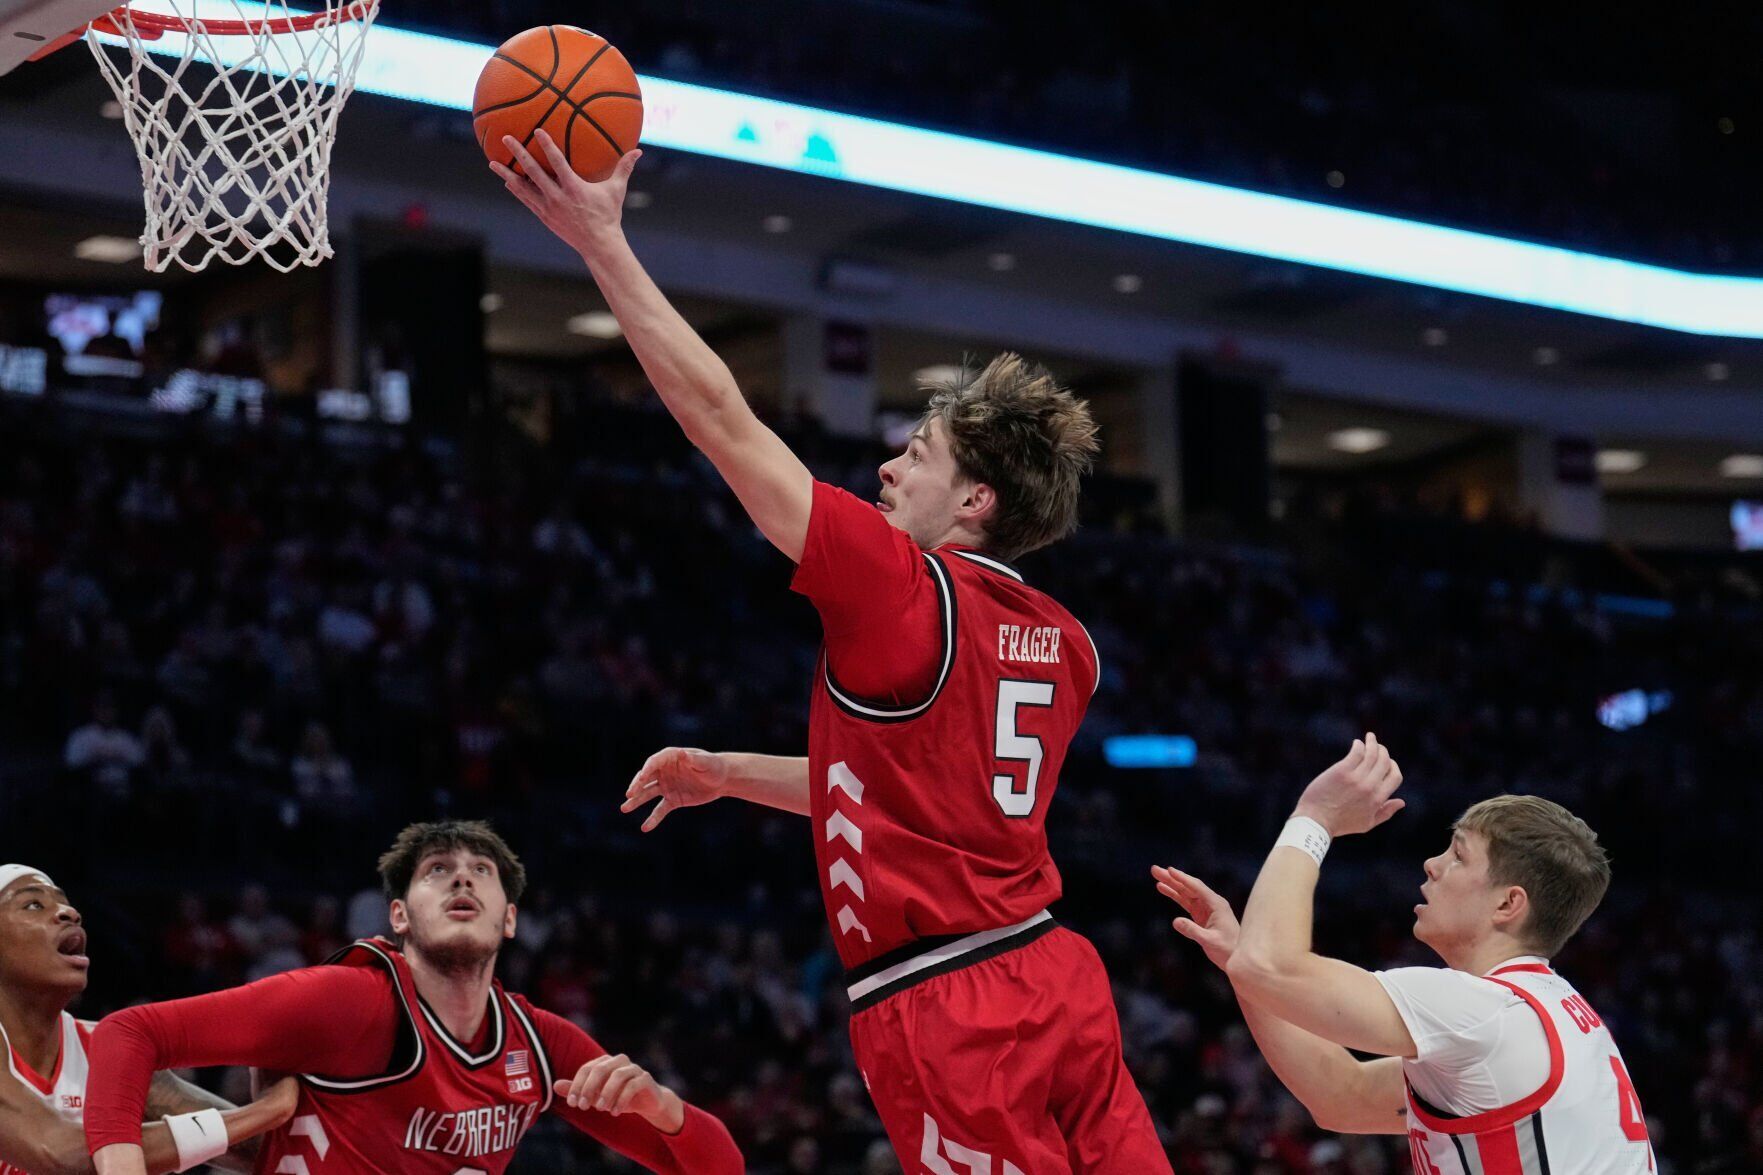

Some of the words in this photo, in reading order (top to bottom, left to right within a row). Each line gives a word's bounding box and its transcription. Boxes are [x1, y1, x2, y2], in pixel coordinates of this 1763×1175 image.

[997, 623, 1061, 664] FRAGER
[991, 677, 1057, 819] 5
[404, 1100, 539, 1158] NEBRASKA
[1608, 1054, 1653, 1172] 4
